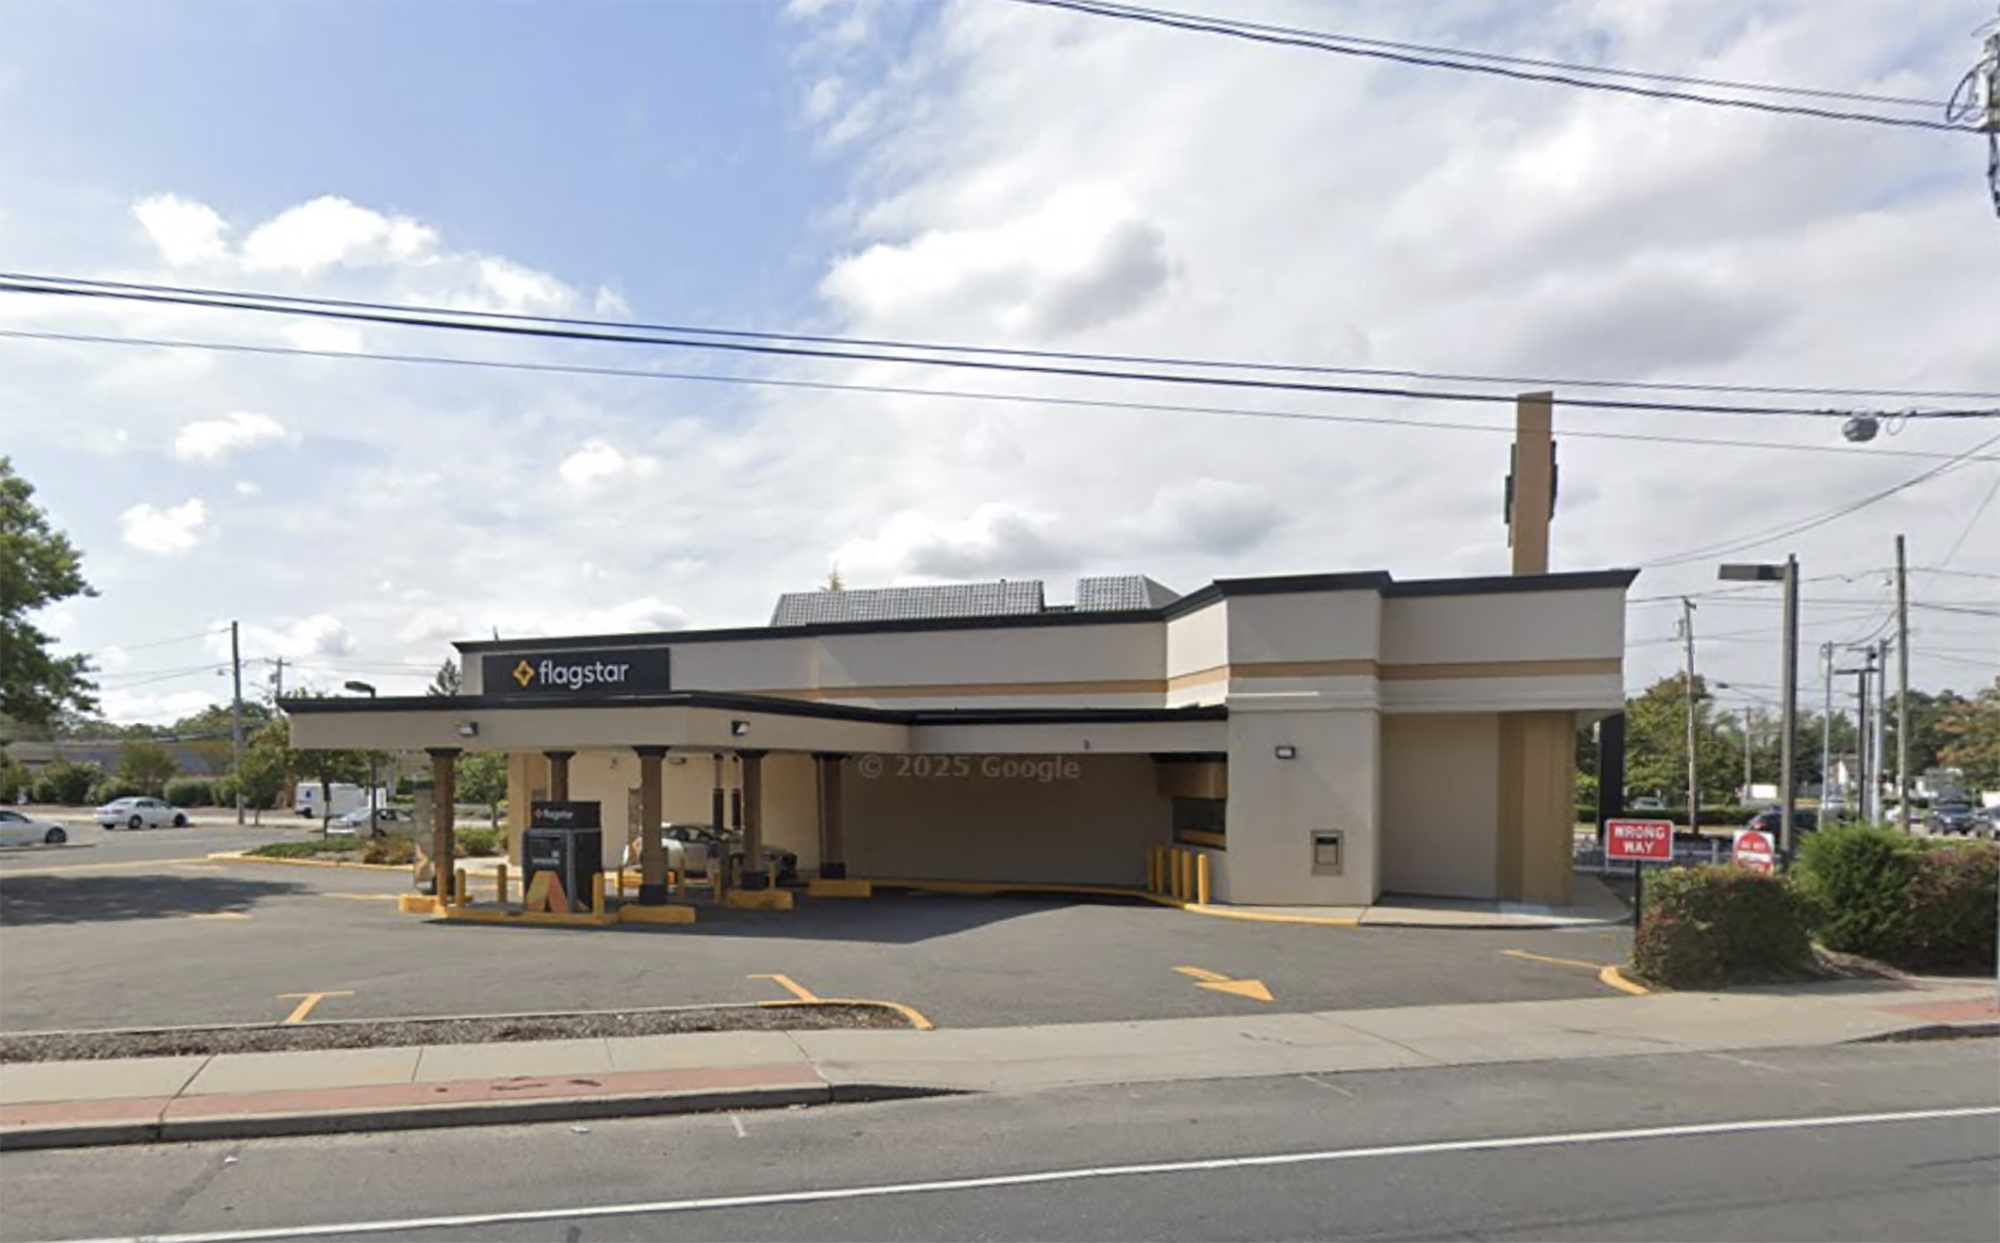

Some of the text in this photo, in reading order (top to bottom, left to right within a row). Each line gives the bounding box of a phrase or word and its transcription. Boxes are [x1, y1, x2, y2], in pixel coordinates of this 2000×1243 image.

[539, 659, 629, 690] flagstar
[1614, 825, 1665, 839] WRONG
[1623, 841, 1654, 853] WAY
